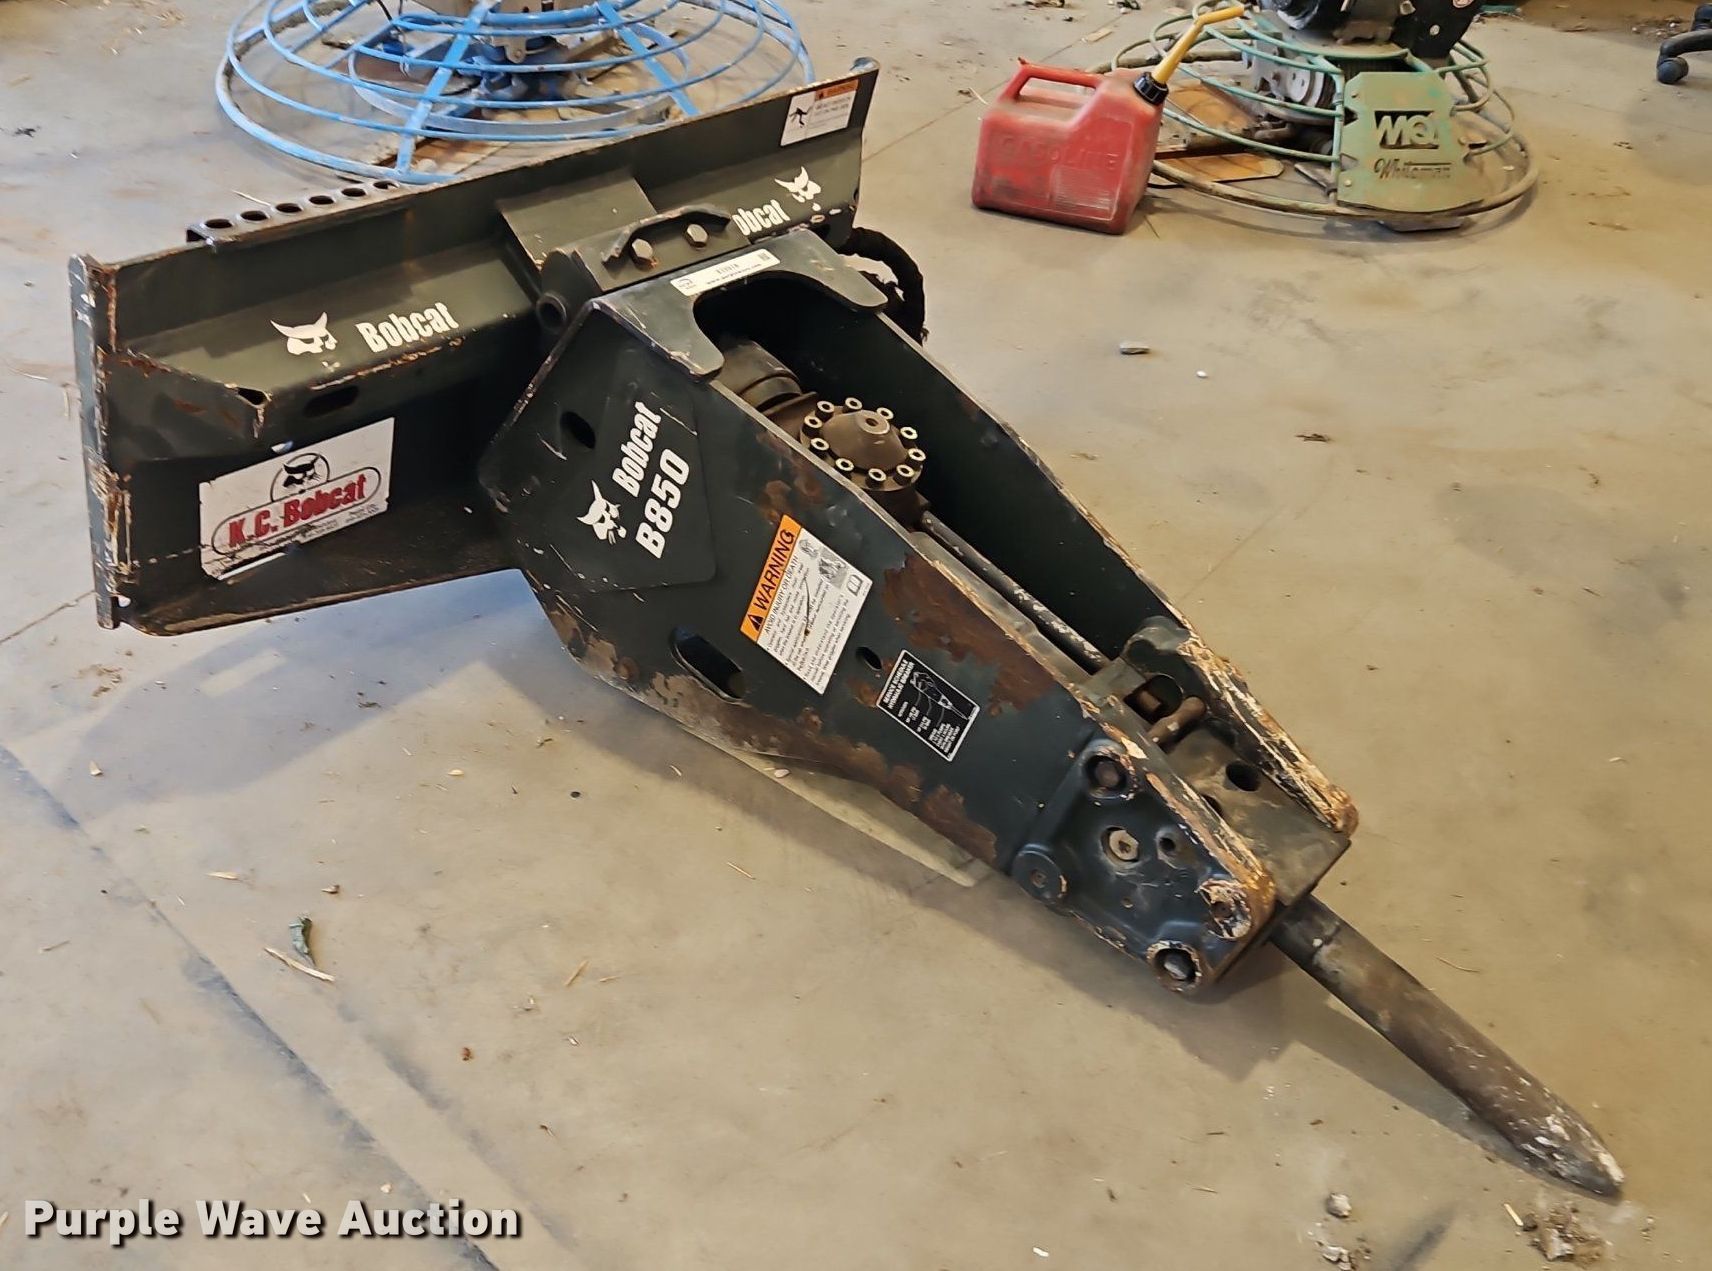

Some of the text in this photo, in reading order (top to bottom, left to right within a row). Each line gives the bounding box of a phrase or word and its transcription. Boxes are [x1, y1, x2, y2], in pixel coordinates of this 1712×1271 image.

[732, 199, 792, 236] obcat
[355, 302, 460, 353] Bobcat
[612, 401, 662, 498] Bobcat
[228, 510, 279, 549] K.C.
[283, 473, 367, 528] Bobcat
[635, 448, 690, 559] B850
[753, 526, 795, 613] WARNING
[764, 613, 775, 634] AVOID
[771, 589, 785, 614] INJURY
[781, 577, 789, 591] OR
[785, 554, 798, 579] DEATH
